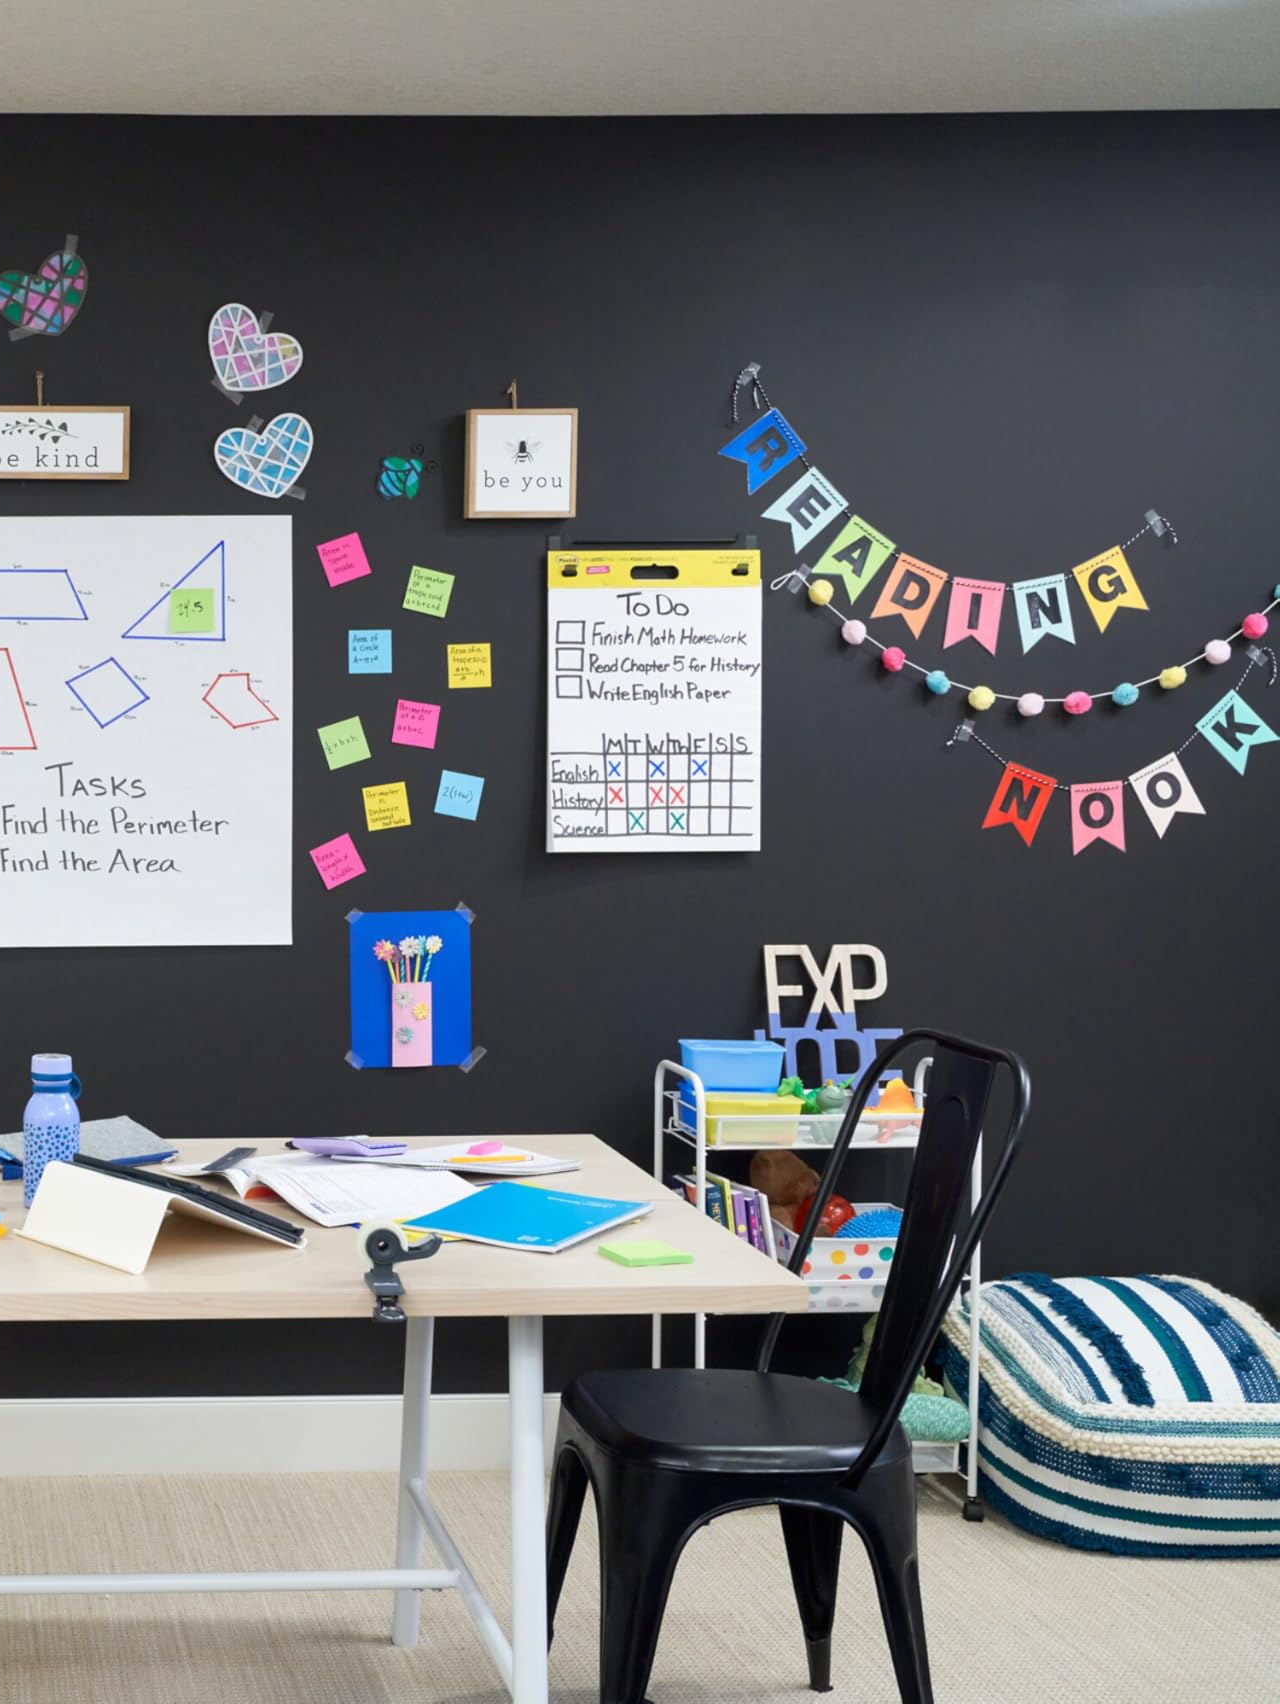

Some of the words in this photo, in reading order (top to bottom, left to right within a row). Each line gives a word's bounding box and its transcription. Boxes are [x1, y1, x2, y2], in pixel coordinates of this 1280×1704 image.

[35, 446, 100, 469] kind
[483, 470, 510, 489] be
[521, 476, 564, 492] you
[744, 425, 1129, 632] READING
[413, 569, 448, 584] Perimeter
[616, 591, 651, 617] To
[655, 593, 690, 617] Do
[591, 621, 634, 647] Finish
[637, 626, 676, 647] Math
[679, 627, 748, 647] Homework
[589, 653, 618, 674] Read
[620, 656, 670, 676] Chapter
[673, 655, 686, 672] 5
[688, 657, 707, 673] for
[709, 656, 761, 677] History
[586, 679, 630, 702] Write
[632, 683, 684, 705] English
[687, 681, 732, 703] Paper
[606, 739, 624, 754] M
[627, 739, 642, 753] T
[648, 739, 665, 754] W
[668, 739, 689, 754] Th
[694, 738, 706, 753] F
[715, 738, 728, 753] S
[736, 737, 749, 754] S
[552, 760, 600, 783] English
[997, 709, 1263, 831] NOOK
[552, 789, 605, 816] History
[1, 804, 48, 836] Find
[56, 808, 99, 836] the
[110, 806, 230, 836] Perimeter
[553, 814, 604, 836] Science
[0, 847, 49, 873] Find
[58, 849, 101, 872] the
[108, 848, 182, 874] Area
